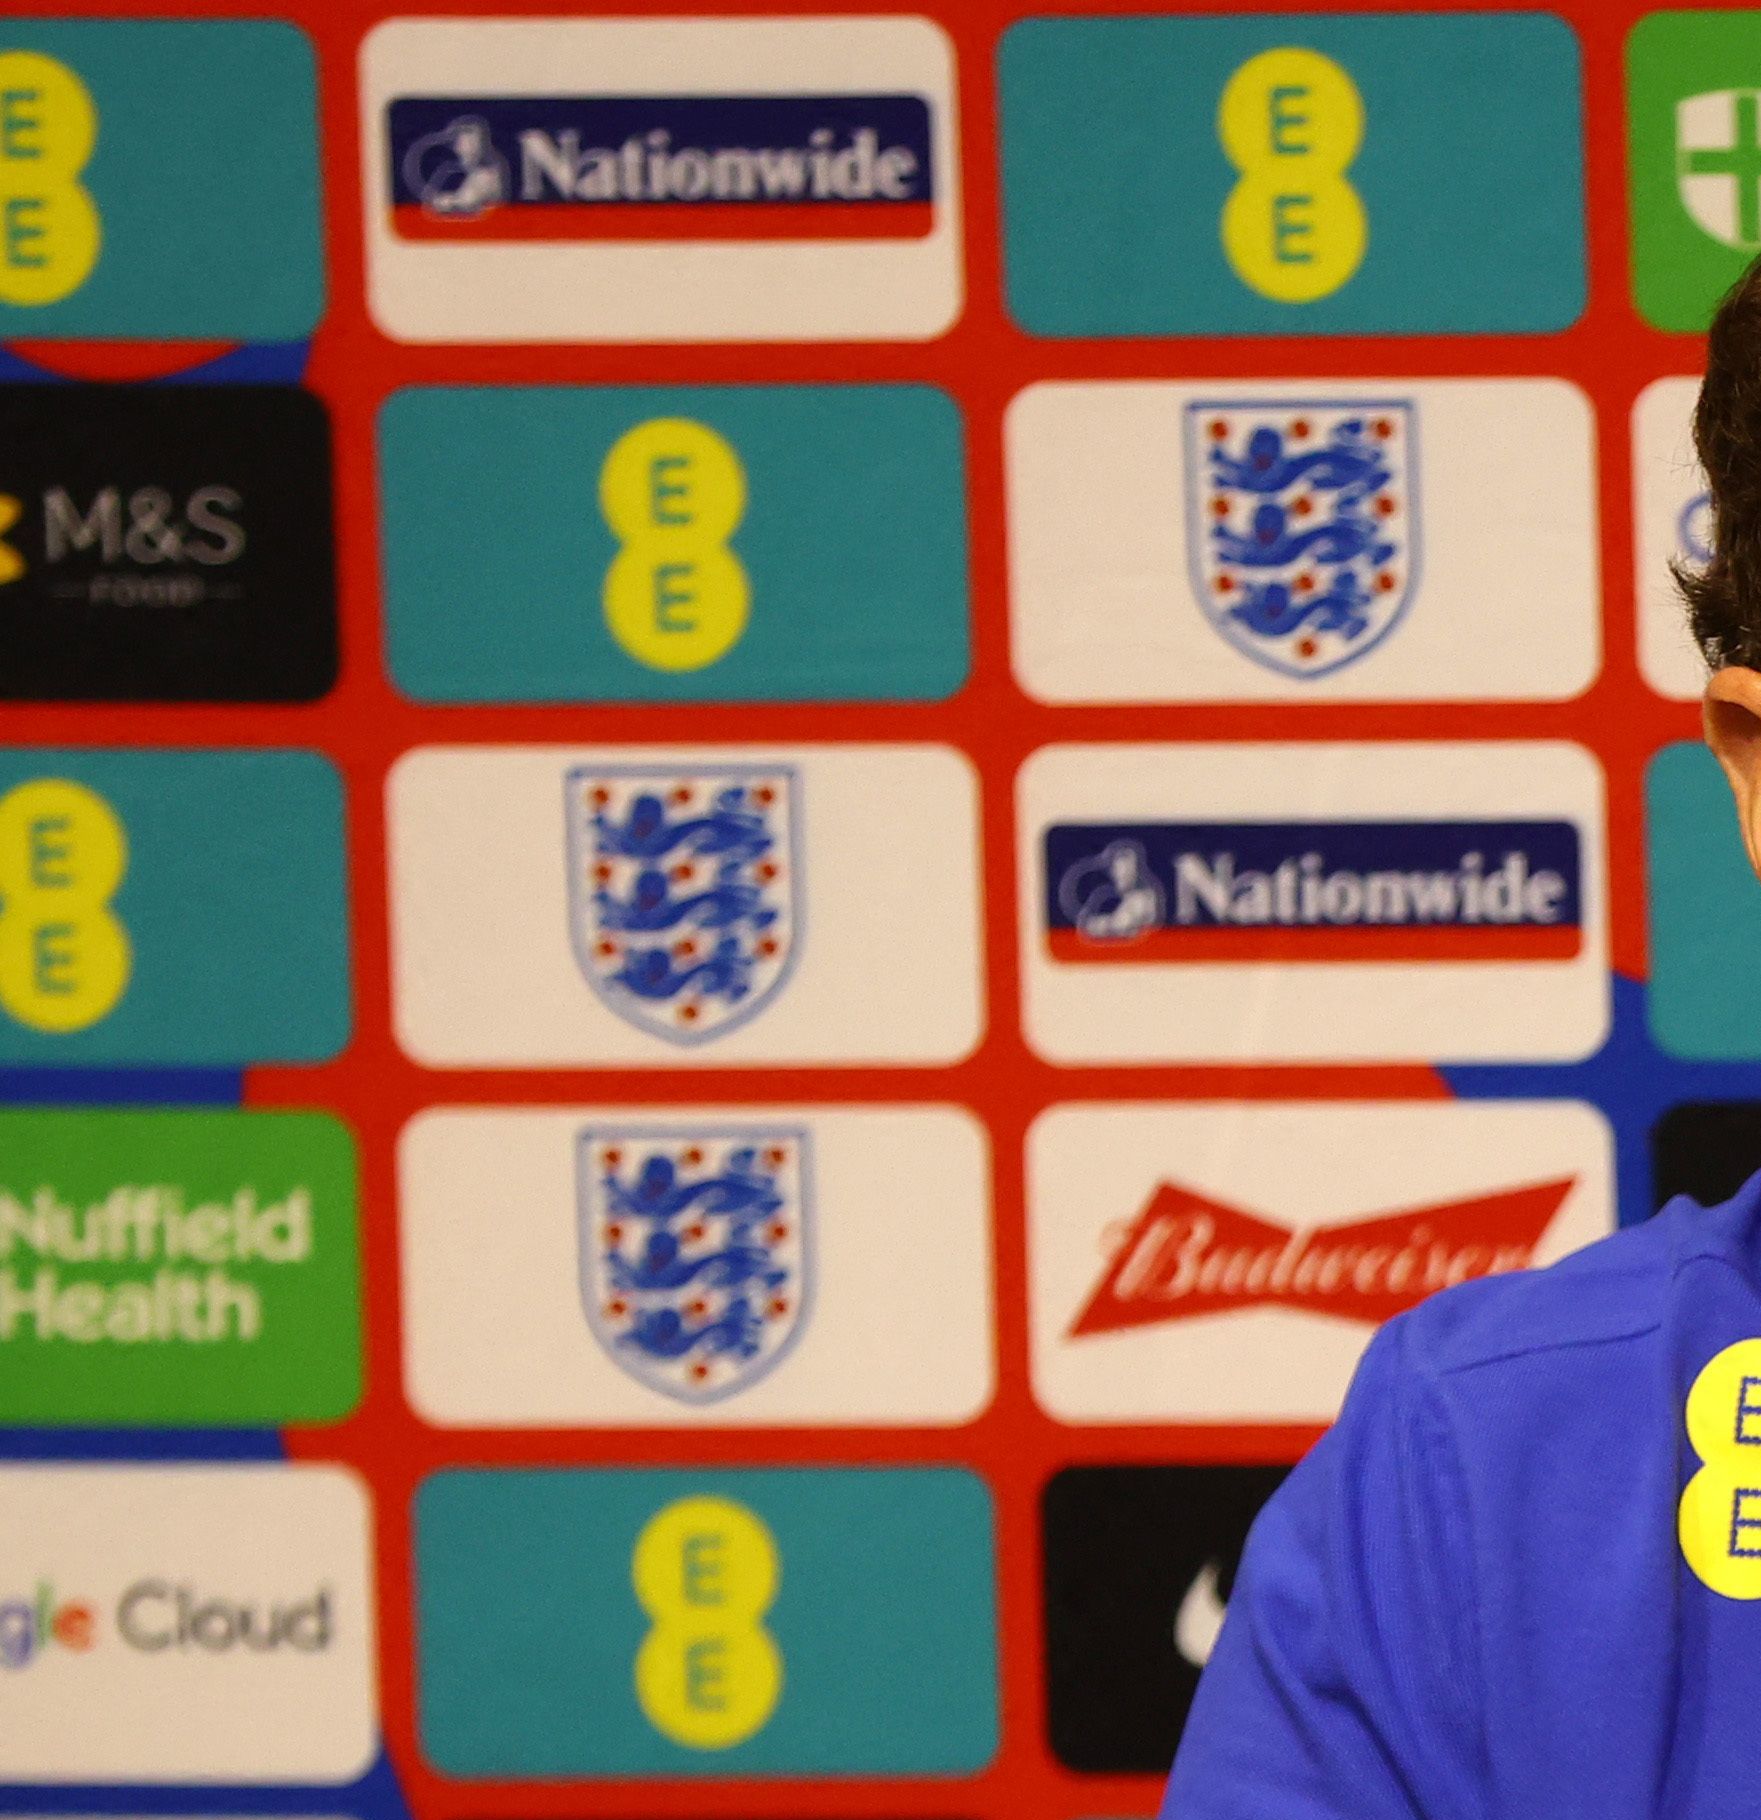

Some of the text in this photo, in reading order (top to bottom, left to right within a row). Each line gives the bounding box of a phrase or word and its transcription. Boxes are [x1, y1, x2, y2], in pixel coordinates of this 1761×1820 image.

[518, 127, 917, 199] Nationwide
[44, 485, 246, 565] M&S
[1172, 848, 1567, 924] Nationwide
[0, 1185, 312, 1263] Nuffield
[0, 1266, 263, 1342] Health
[116, 1578, 333, 1653] Cloud
